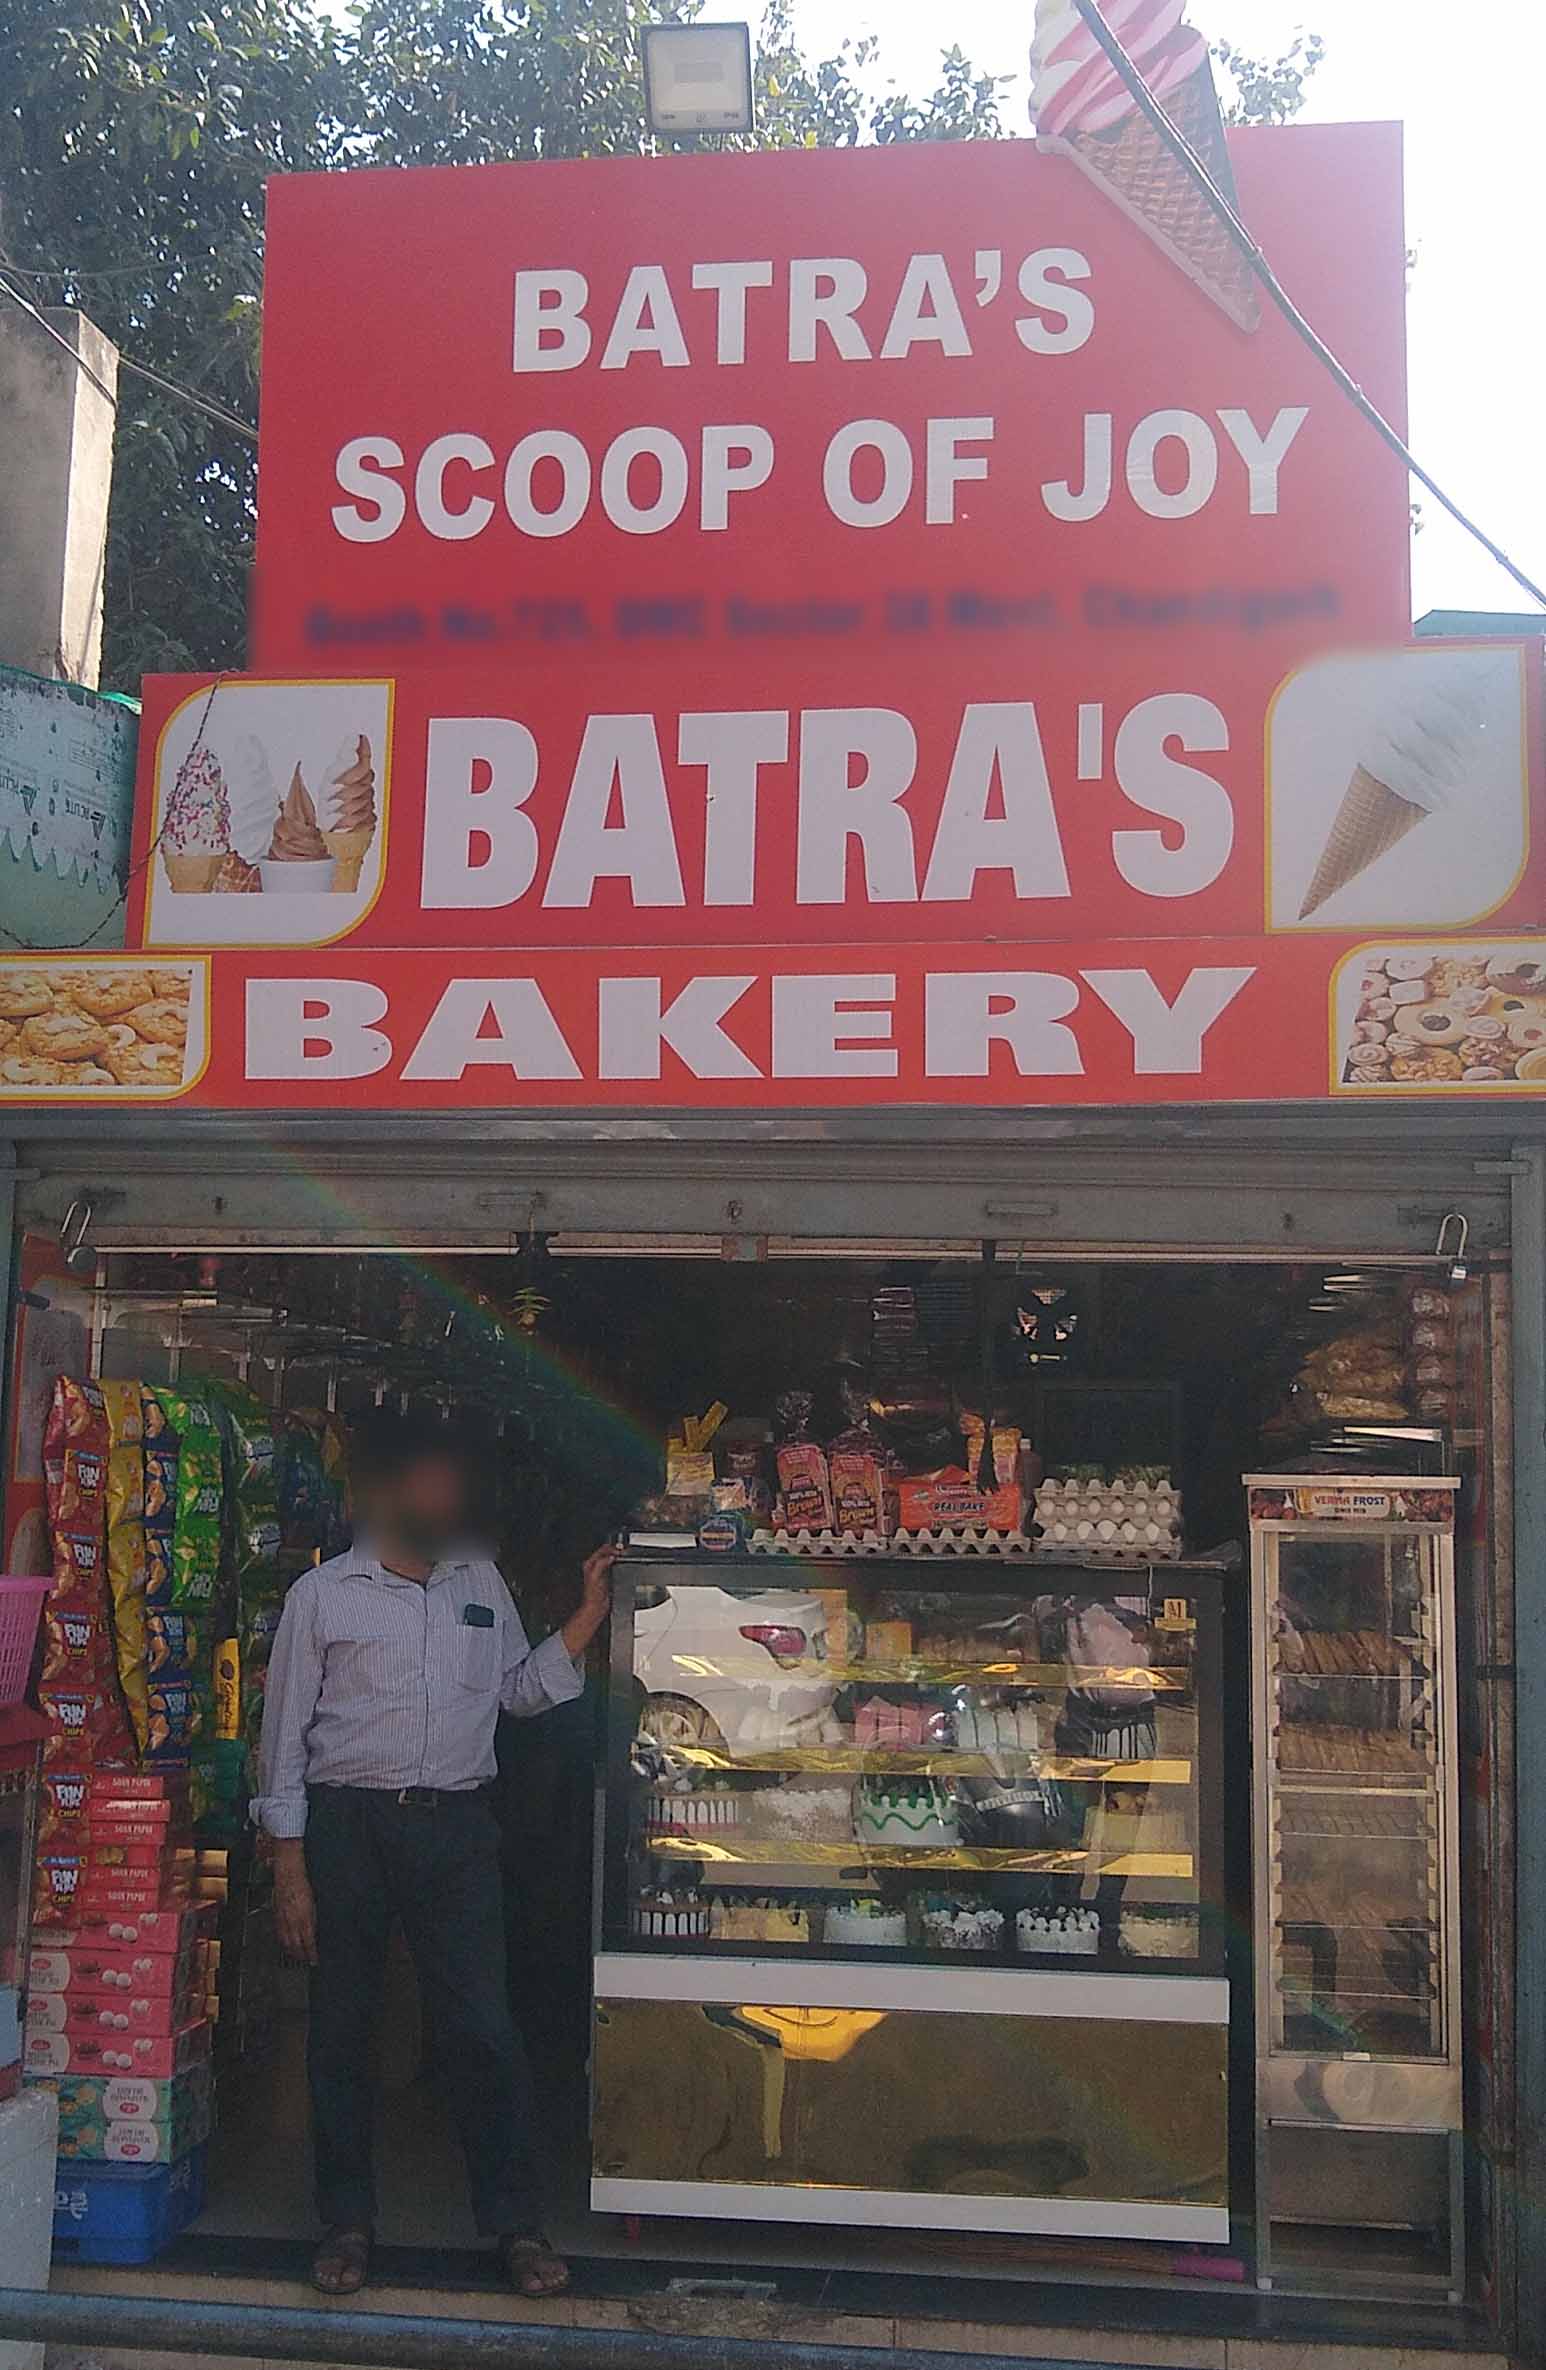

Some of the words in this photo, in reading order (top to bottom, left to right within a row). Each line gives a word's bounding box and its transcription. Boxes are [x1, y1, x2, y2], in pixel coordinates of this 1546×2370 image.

[513, 248, 1095, 373] BATRA'S
[332, 426, 774, 542] SCOOP
[823, 417, 995, 528] OF
[1041, 406, 1311, 522] JOY
[419, 693, 1235, 910] BATRA'S
[243, 967, 1257, 1082] BAKERY
[840, 1507, 876, 1522] Brown
[1352, 1496, 1386, 1506] FROST
